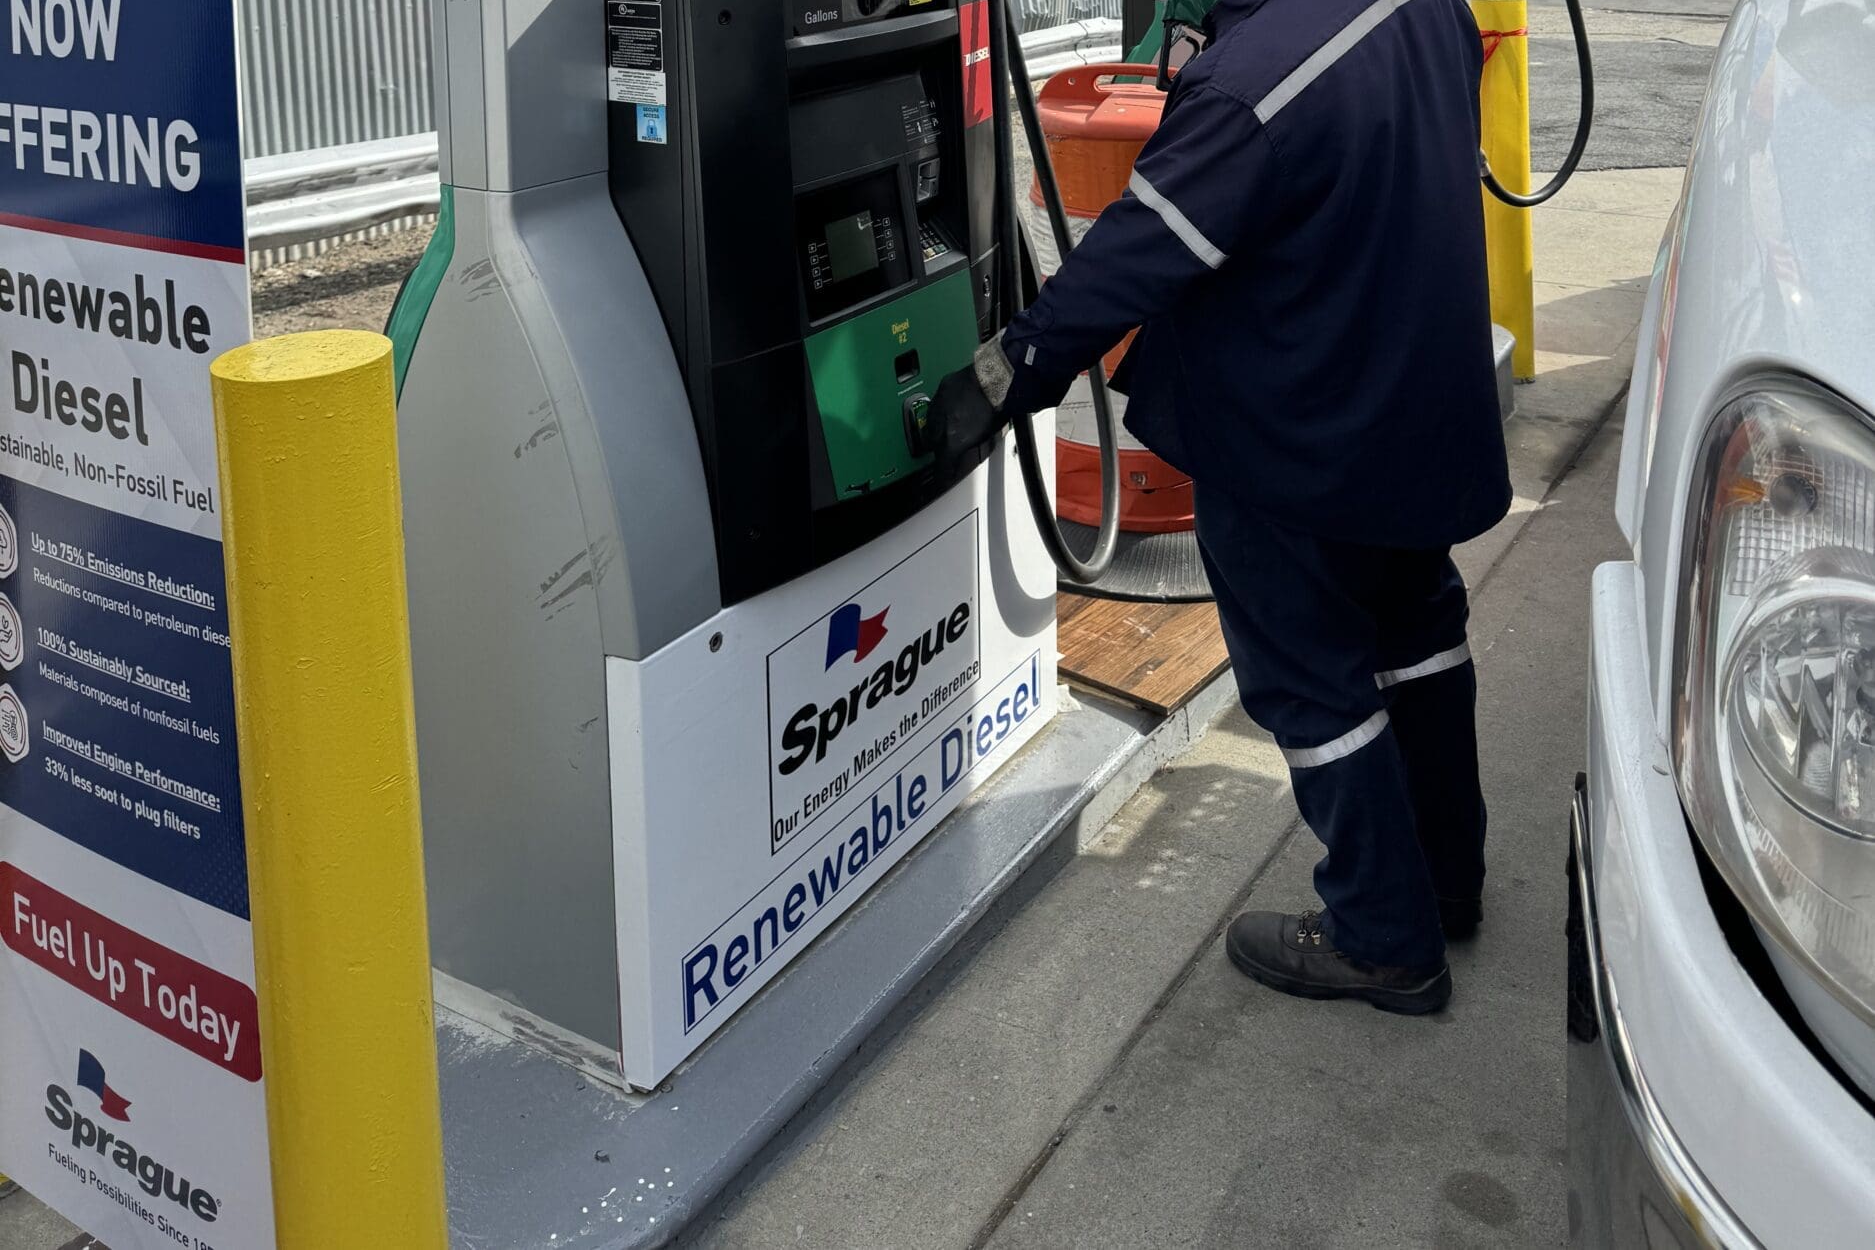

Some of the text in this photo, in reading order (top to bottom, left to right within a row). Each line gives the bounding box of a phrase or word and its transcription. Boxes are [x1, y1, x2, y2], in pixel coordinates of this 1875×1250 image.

[804, 9, 838, 25] Gallons
[891, 317, 910, 335] Diesel
[12, 350, 149, 446] Diesel
[0, 433, 215, 514] stainable, Non-Fossil Fuel
[31, 532, 216, 608] Up to 75% Emissions Reduction:
[33, 567, 81, 598] Reductions
[82, 589, 131, 617] compared
[132, 602, 143, 620] to
[145, 607, 200, 639] petroleum
[38, 627, 191, 700] 100% Sustainably Sourced:
[39, 661, 220, 745] Materials composed of nonfossil fuels
[778, 602, 971, 777] Sprague
[43, 720, 221, 810] Improved Engine Performance:
[774, 660, 979, 843] Our Energy Makes the Difference
[45, 756, 201, 840] 33% less soot to plug filters
[684, 655, 1040, 1027] Renewable Diesel
[13, 891, 241, 1062] Fuel Up Today
[44, 1083, 219, 1224] Sprague
[48, 1142, 87, 1184] Fueling
[89, 1170, 155, 1225] Possibilities
[157, 1215, 189, 1247] Since
